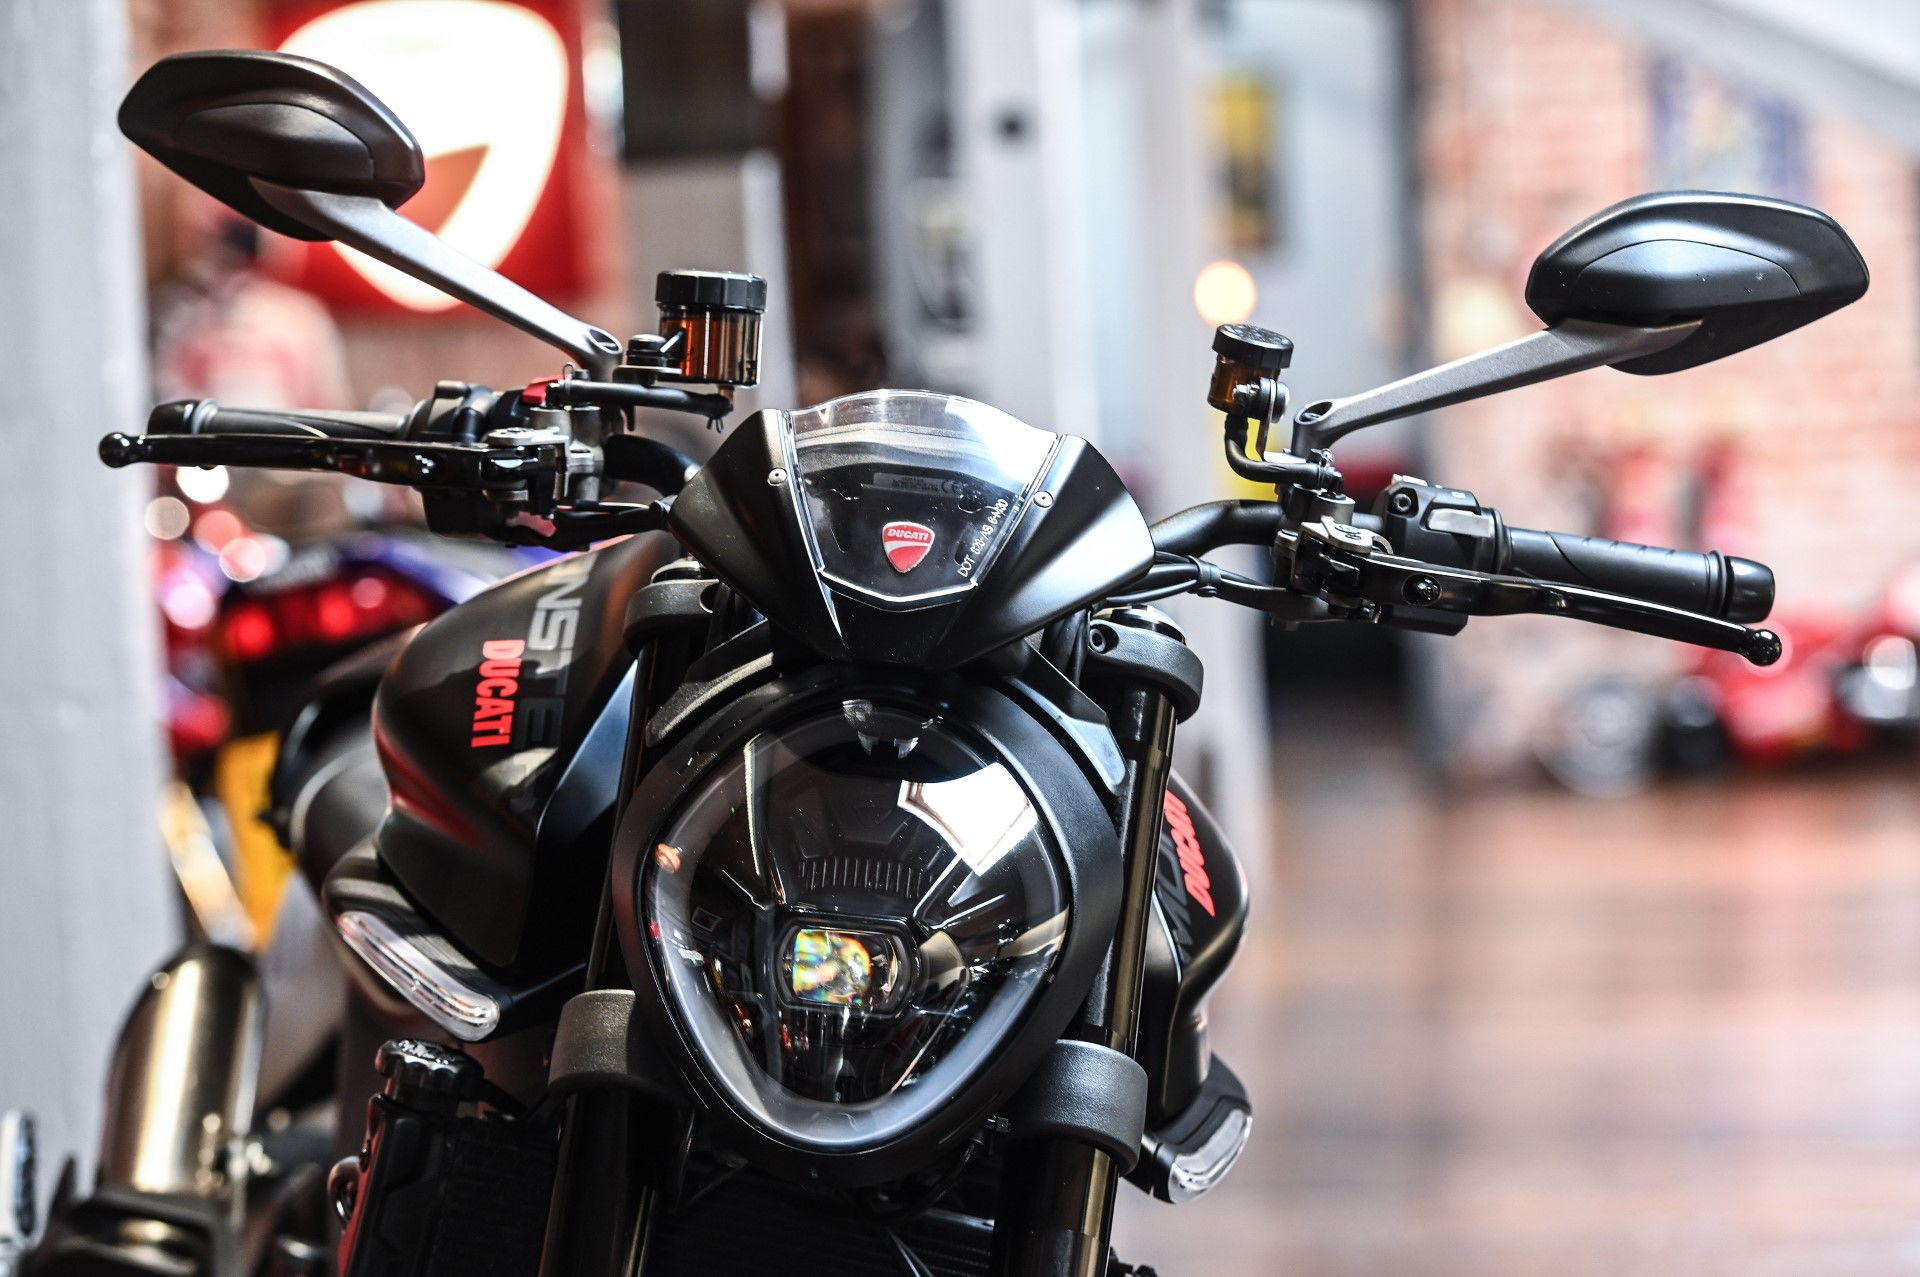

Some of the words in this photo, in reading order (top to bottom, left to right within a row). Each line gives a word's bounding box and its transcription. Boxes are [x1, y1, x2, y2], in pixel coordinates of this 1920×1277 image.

[887, 528, 929, 541] DUCATI
[957, 554, 975, 577] DOT
[471, 640, 526, 747] DUCATI
